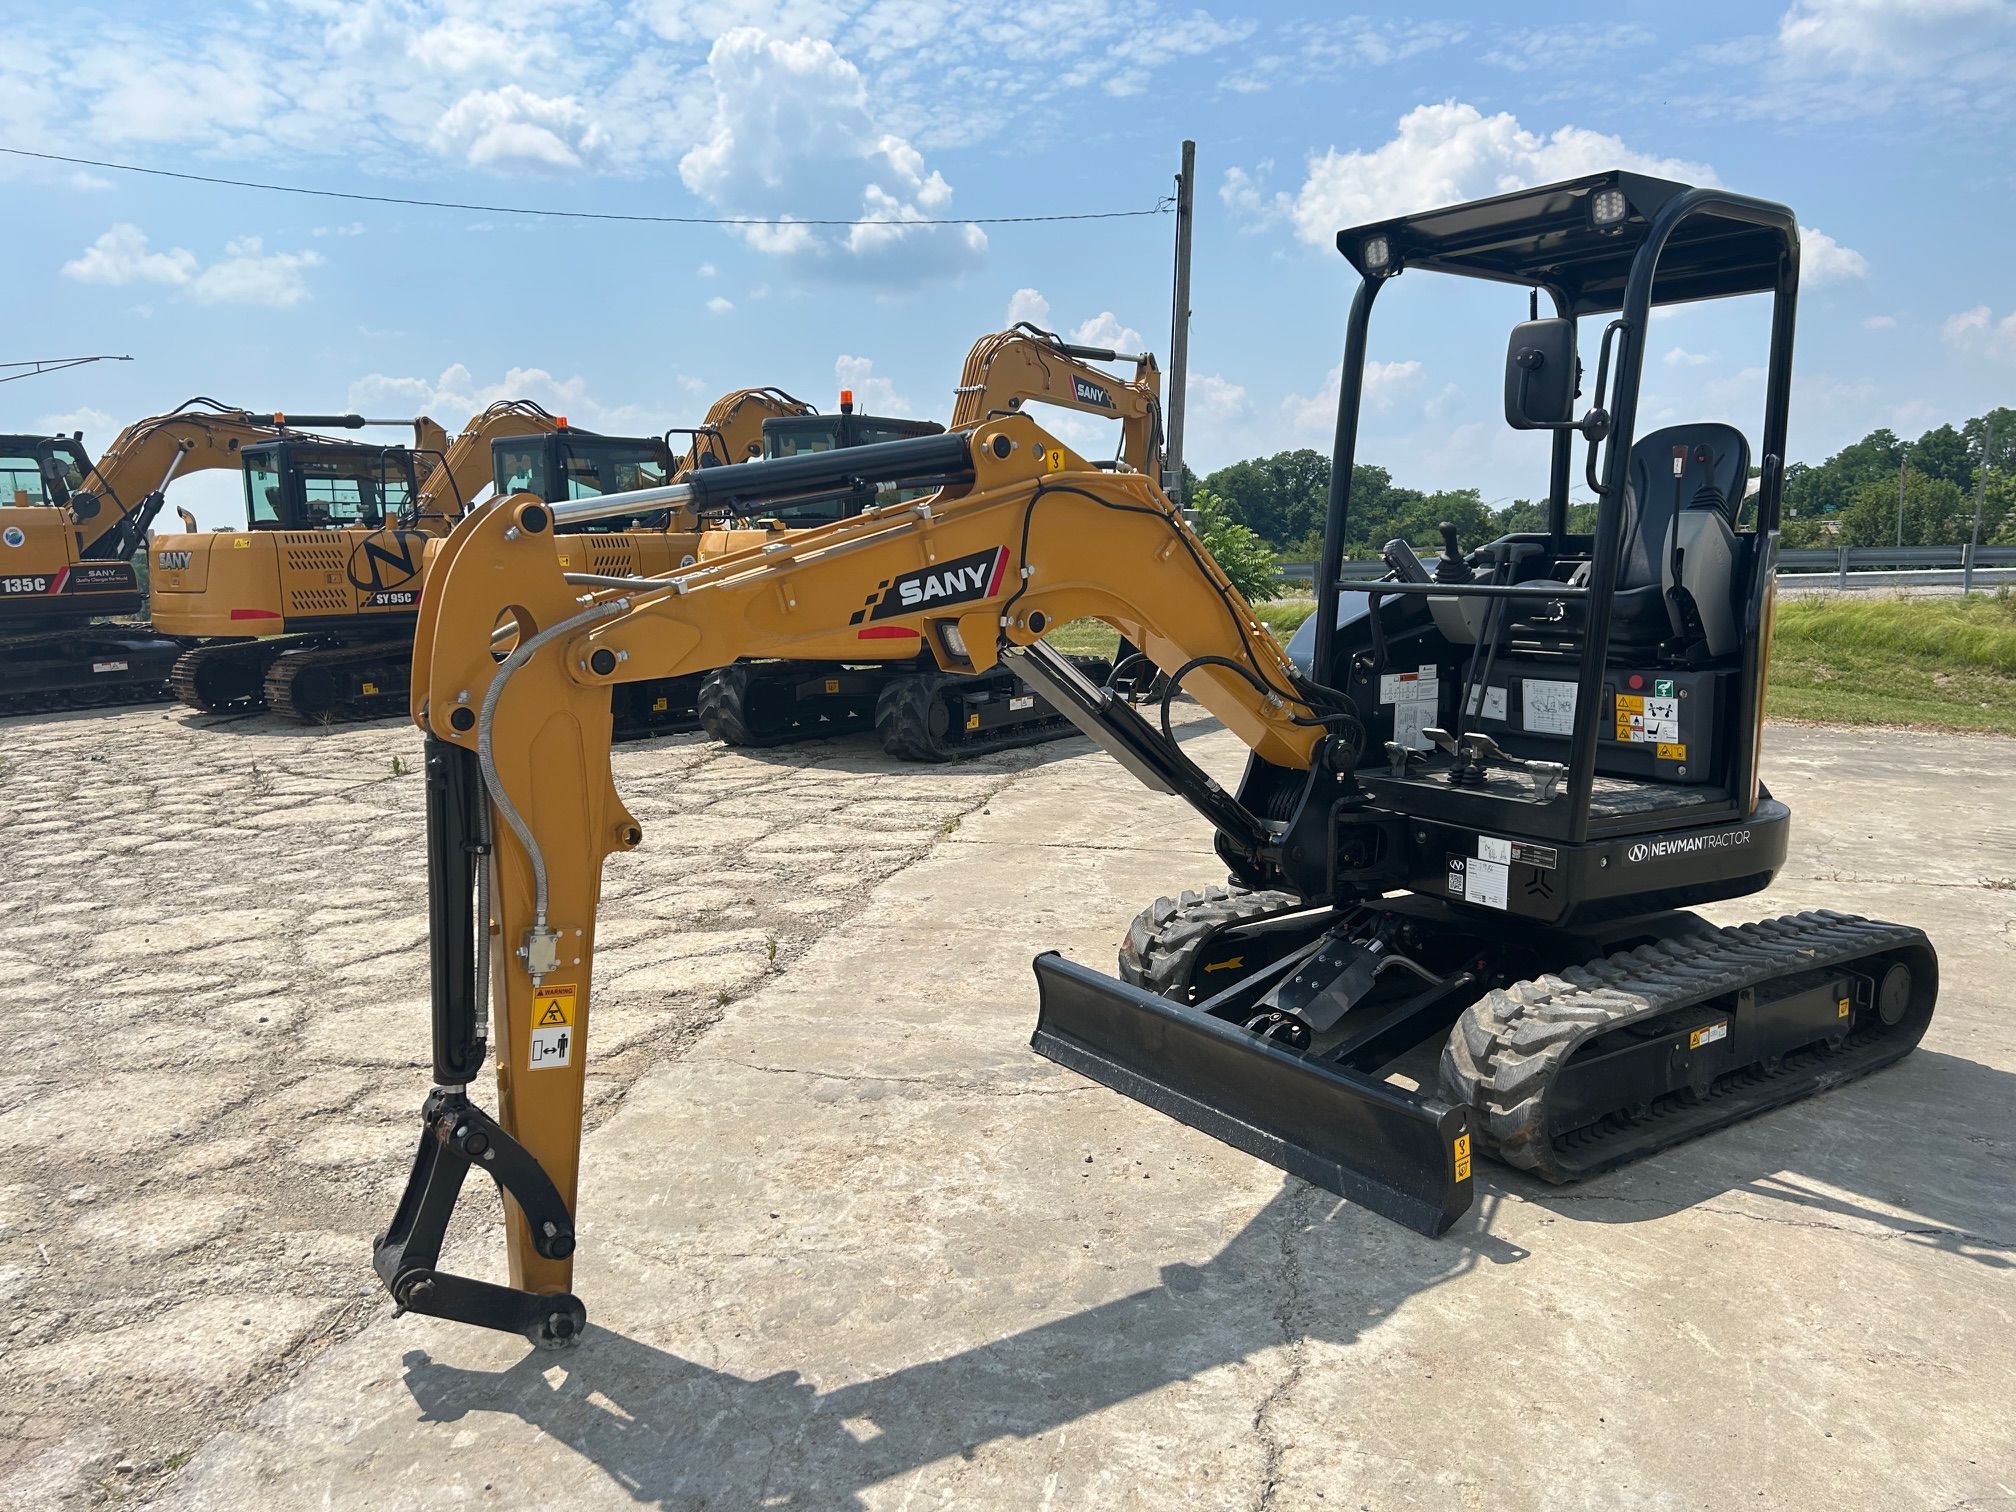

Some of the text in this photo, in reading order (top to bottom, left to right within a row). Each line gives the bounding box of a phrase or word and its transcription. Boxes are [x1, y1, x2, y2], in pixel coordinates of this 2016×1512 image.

[1077, 383, 1104, 402] SANY
[159, 552, 192, 569] SANY
[88, 569, 116, 577] SANY
[2, 578, 46, 592] 135C
[899, 563, 988, 606] SANY
[1651, 830, 1751, 857] NEWMANTRACTOR
[545, 988, 572, 996] WARNING
